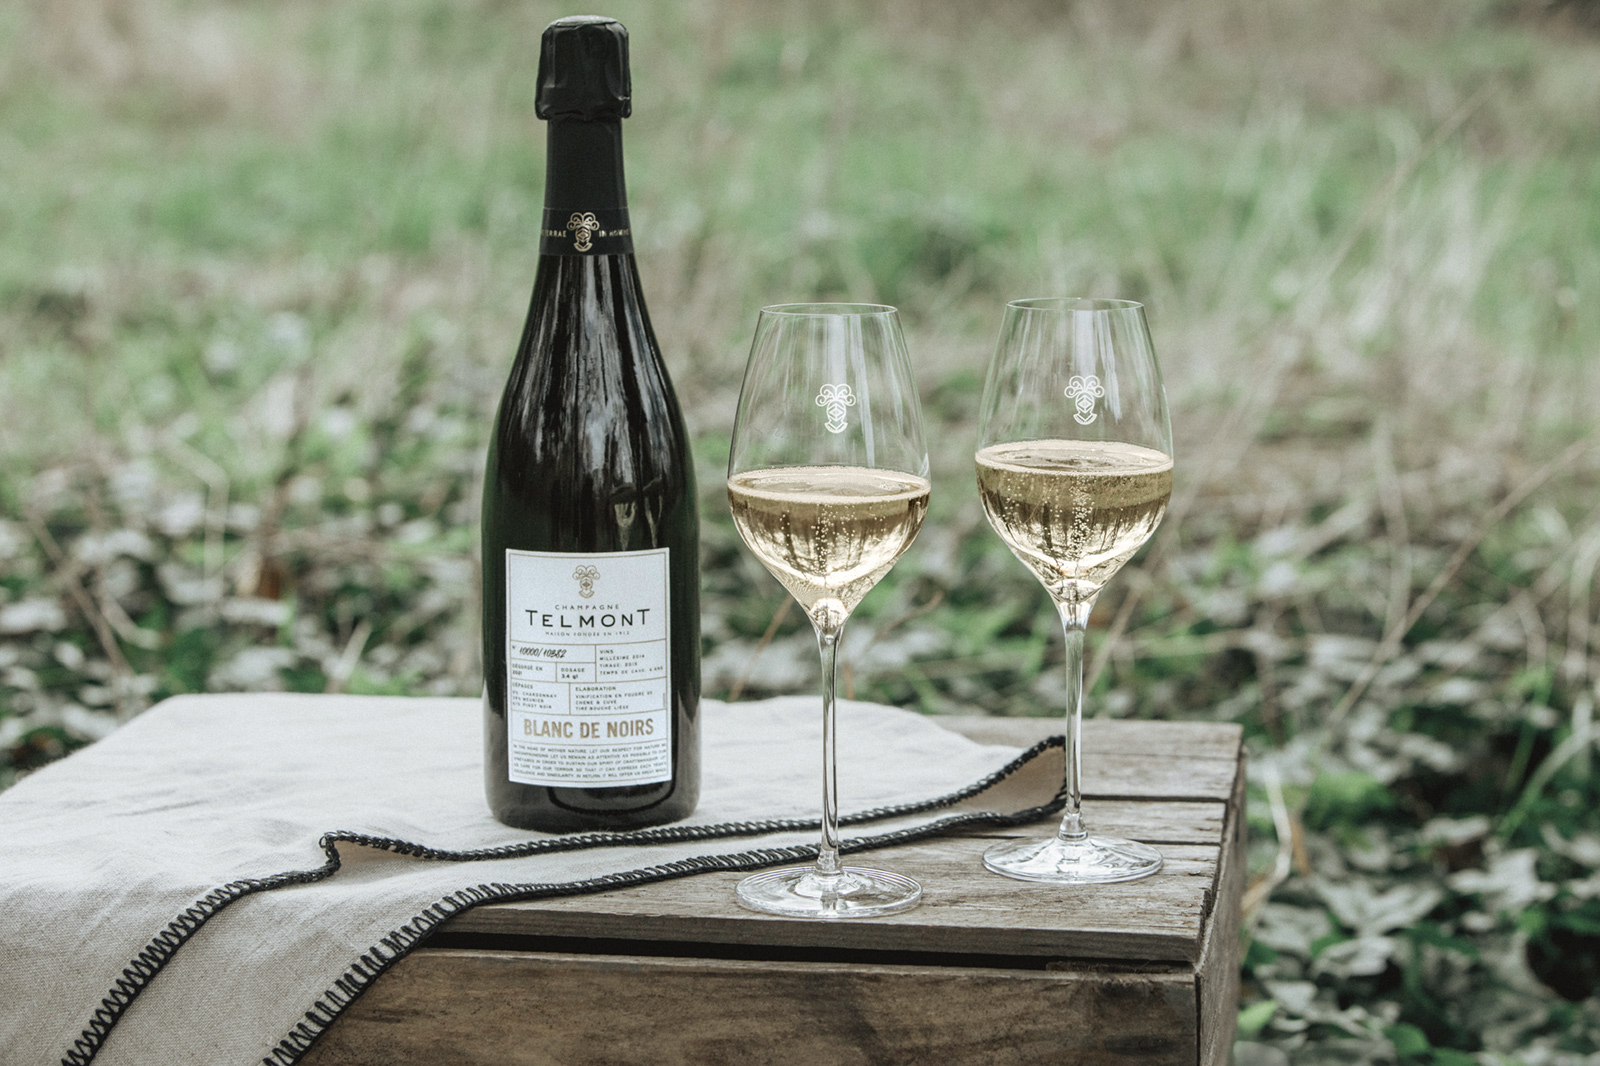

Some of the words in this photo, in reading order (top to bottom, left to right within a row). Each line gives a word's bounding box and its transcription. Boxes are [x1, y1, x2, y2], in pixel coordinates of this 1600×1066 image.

[525, 609, 650, 627] TELMONT
[524, 719, 573, 738] BLANC
[580, 722, 600, 738] DE
[607, 718, 654, 737] NOIRS
